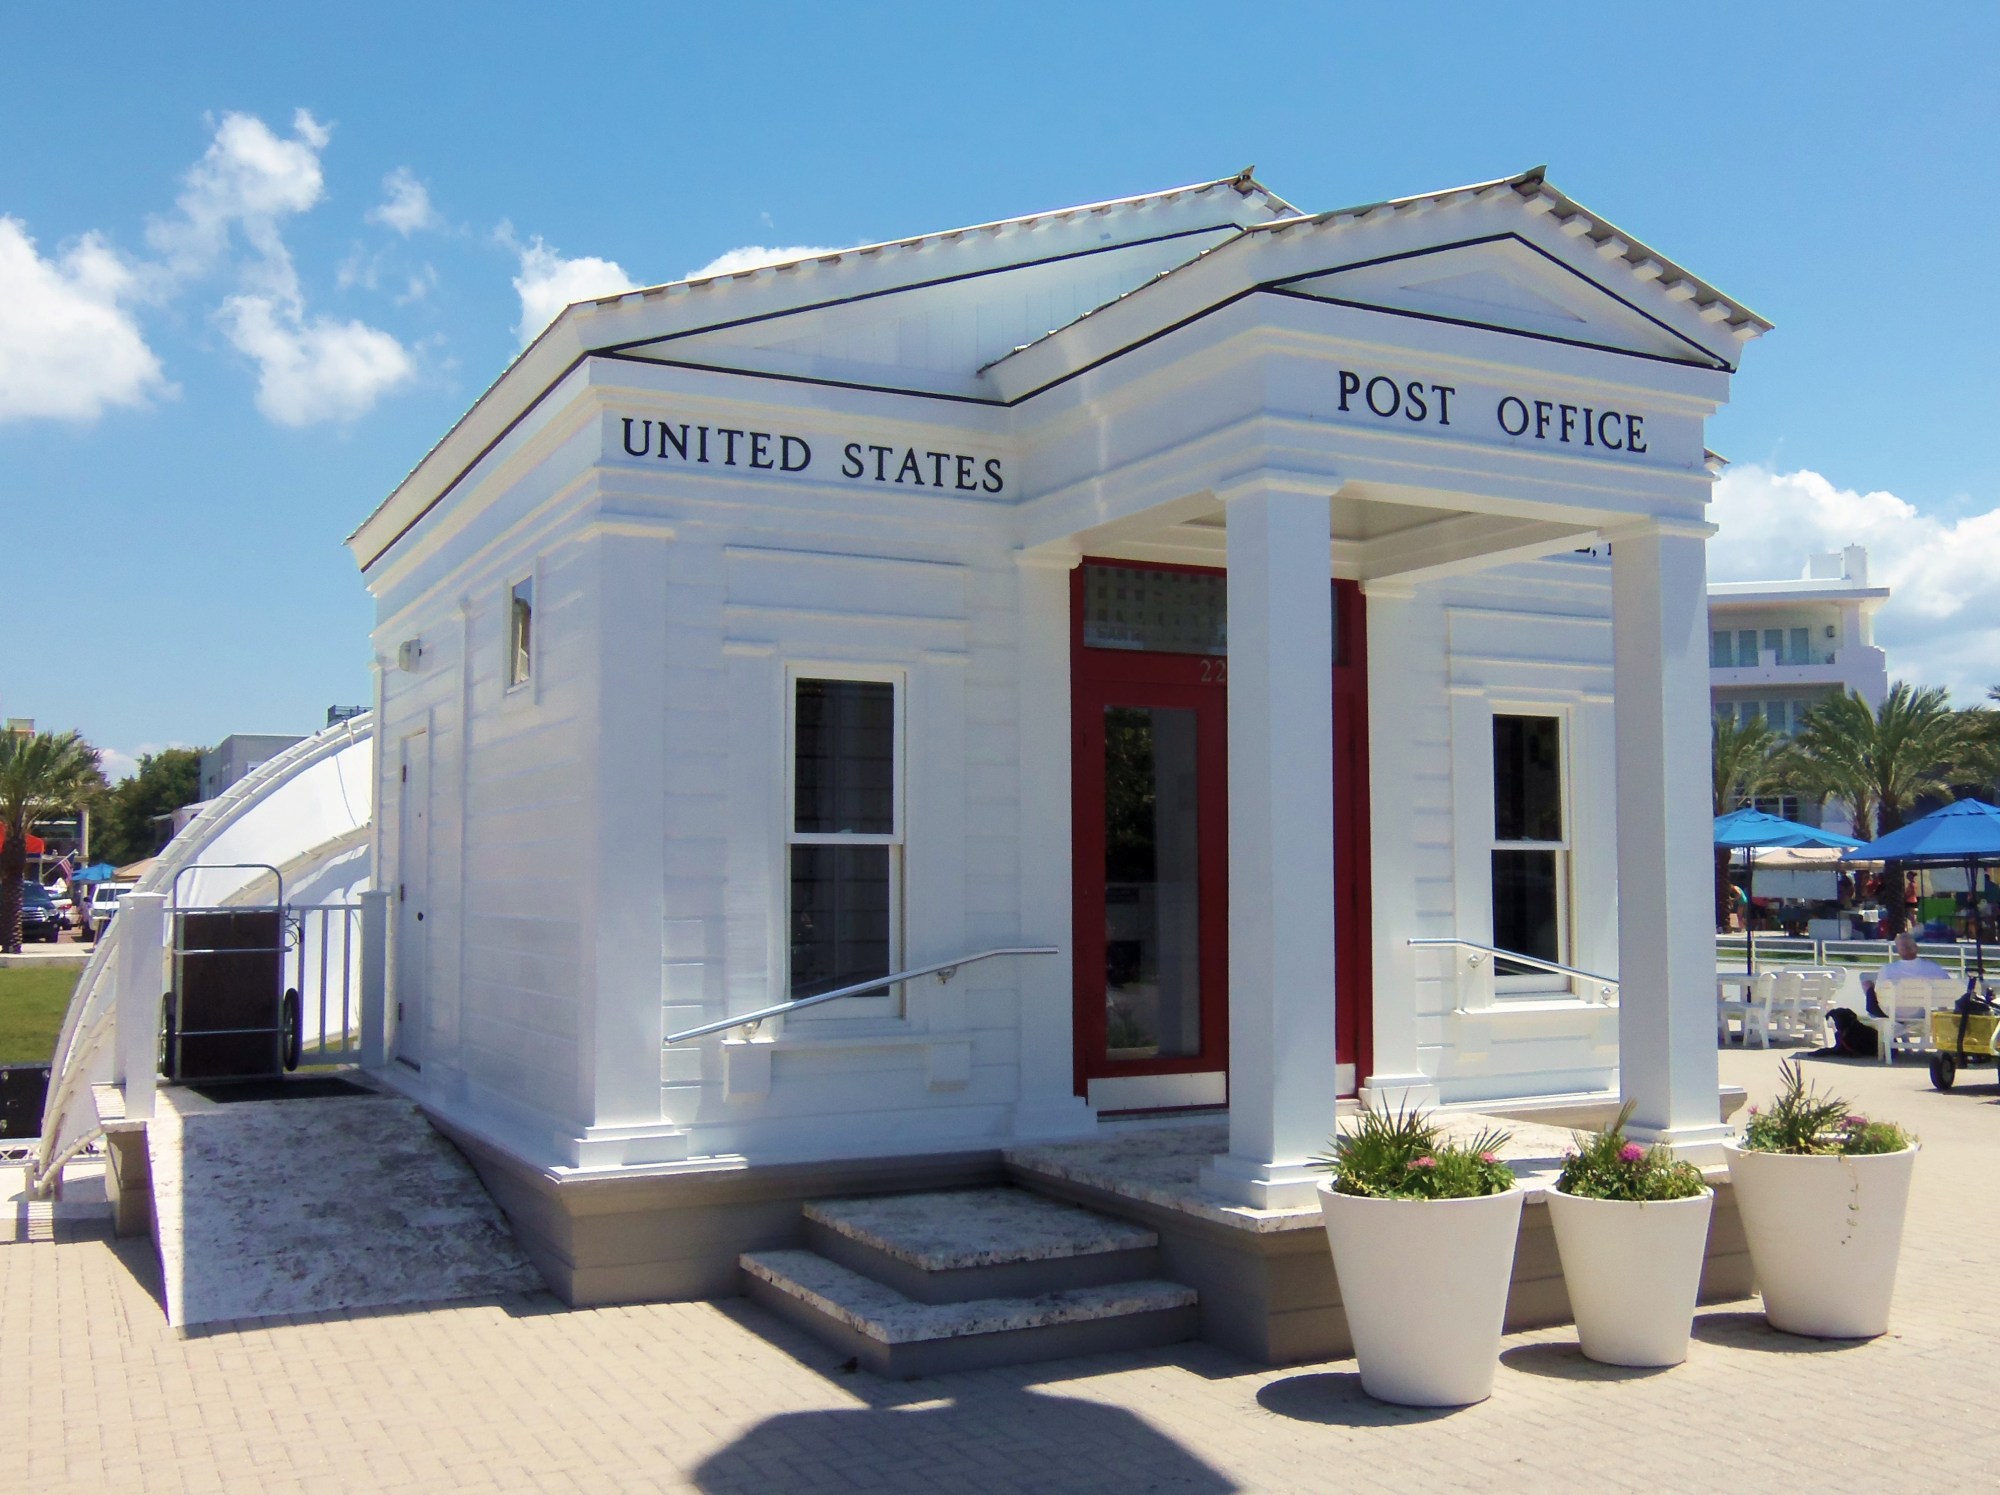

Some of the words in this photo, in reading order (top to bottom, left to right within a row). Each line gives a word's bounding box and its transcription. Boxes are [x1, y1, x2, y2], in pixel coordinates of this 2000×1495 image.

[1338, 370, 1455, 425] POST
[1497, 396, 1647, 453] OFFICE
[621, 417, 811, 472] UNITED
[841, 442, 1004, 493] STATES
